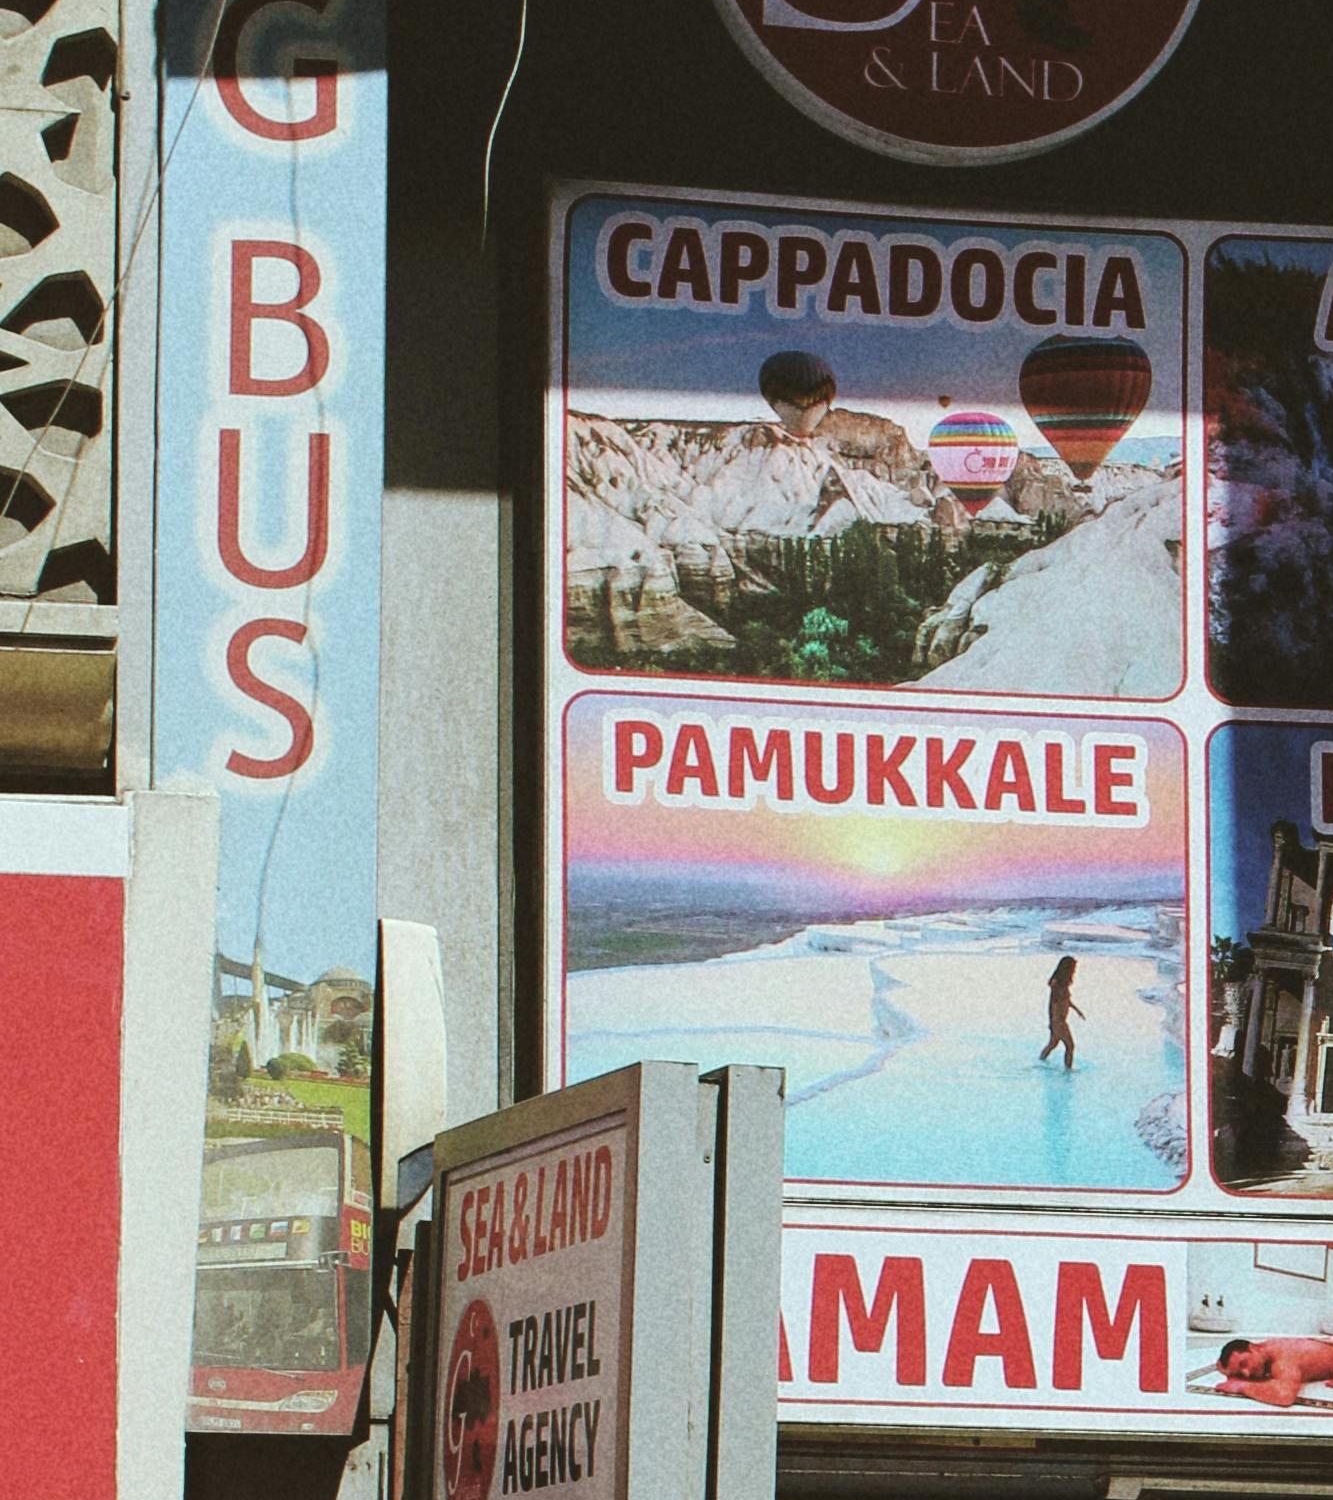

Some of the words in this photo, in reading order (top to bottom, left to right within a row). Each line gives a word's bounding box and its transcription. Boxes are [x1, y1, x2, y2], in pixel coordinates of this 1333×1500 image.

[931, 50, 1084, 102] LAND
[607, 223, 1146, 329] CAPPADOCIA
[217, 241, 334, 781] BUS
[614, 720, 1137, 816] PAMUKKALE
[457, 1176, 506, 1283] SEA
[509, 1172, 529, 1263] &
[534, 1145, 612, 1257] LAND
[509, 1301, 601, 1395] TRAVEL
[502, 1400, 601, 1496] AGENCY
